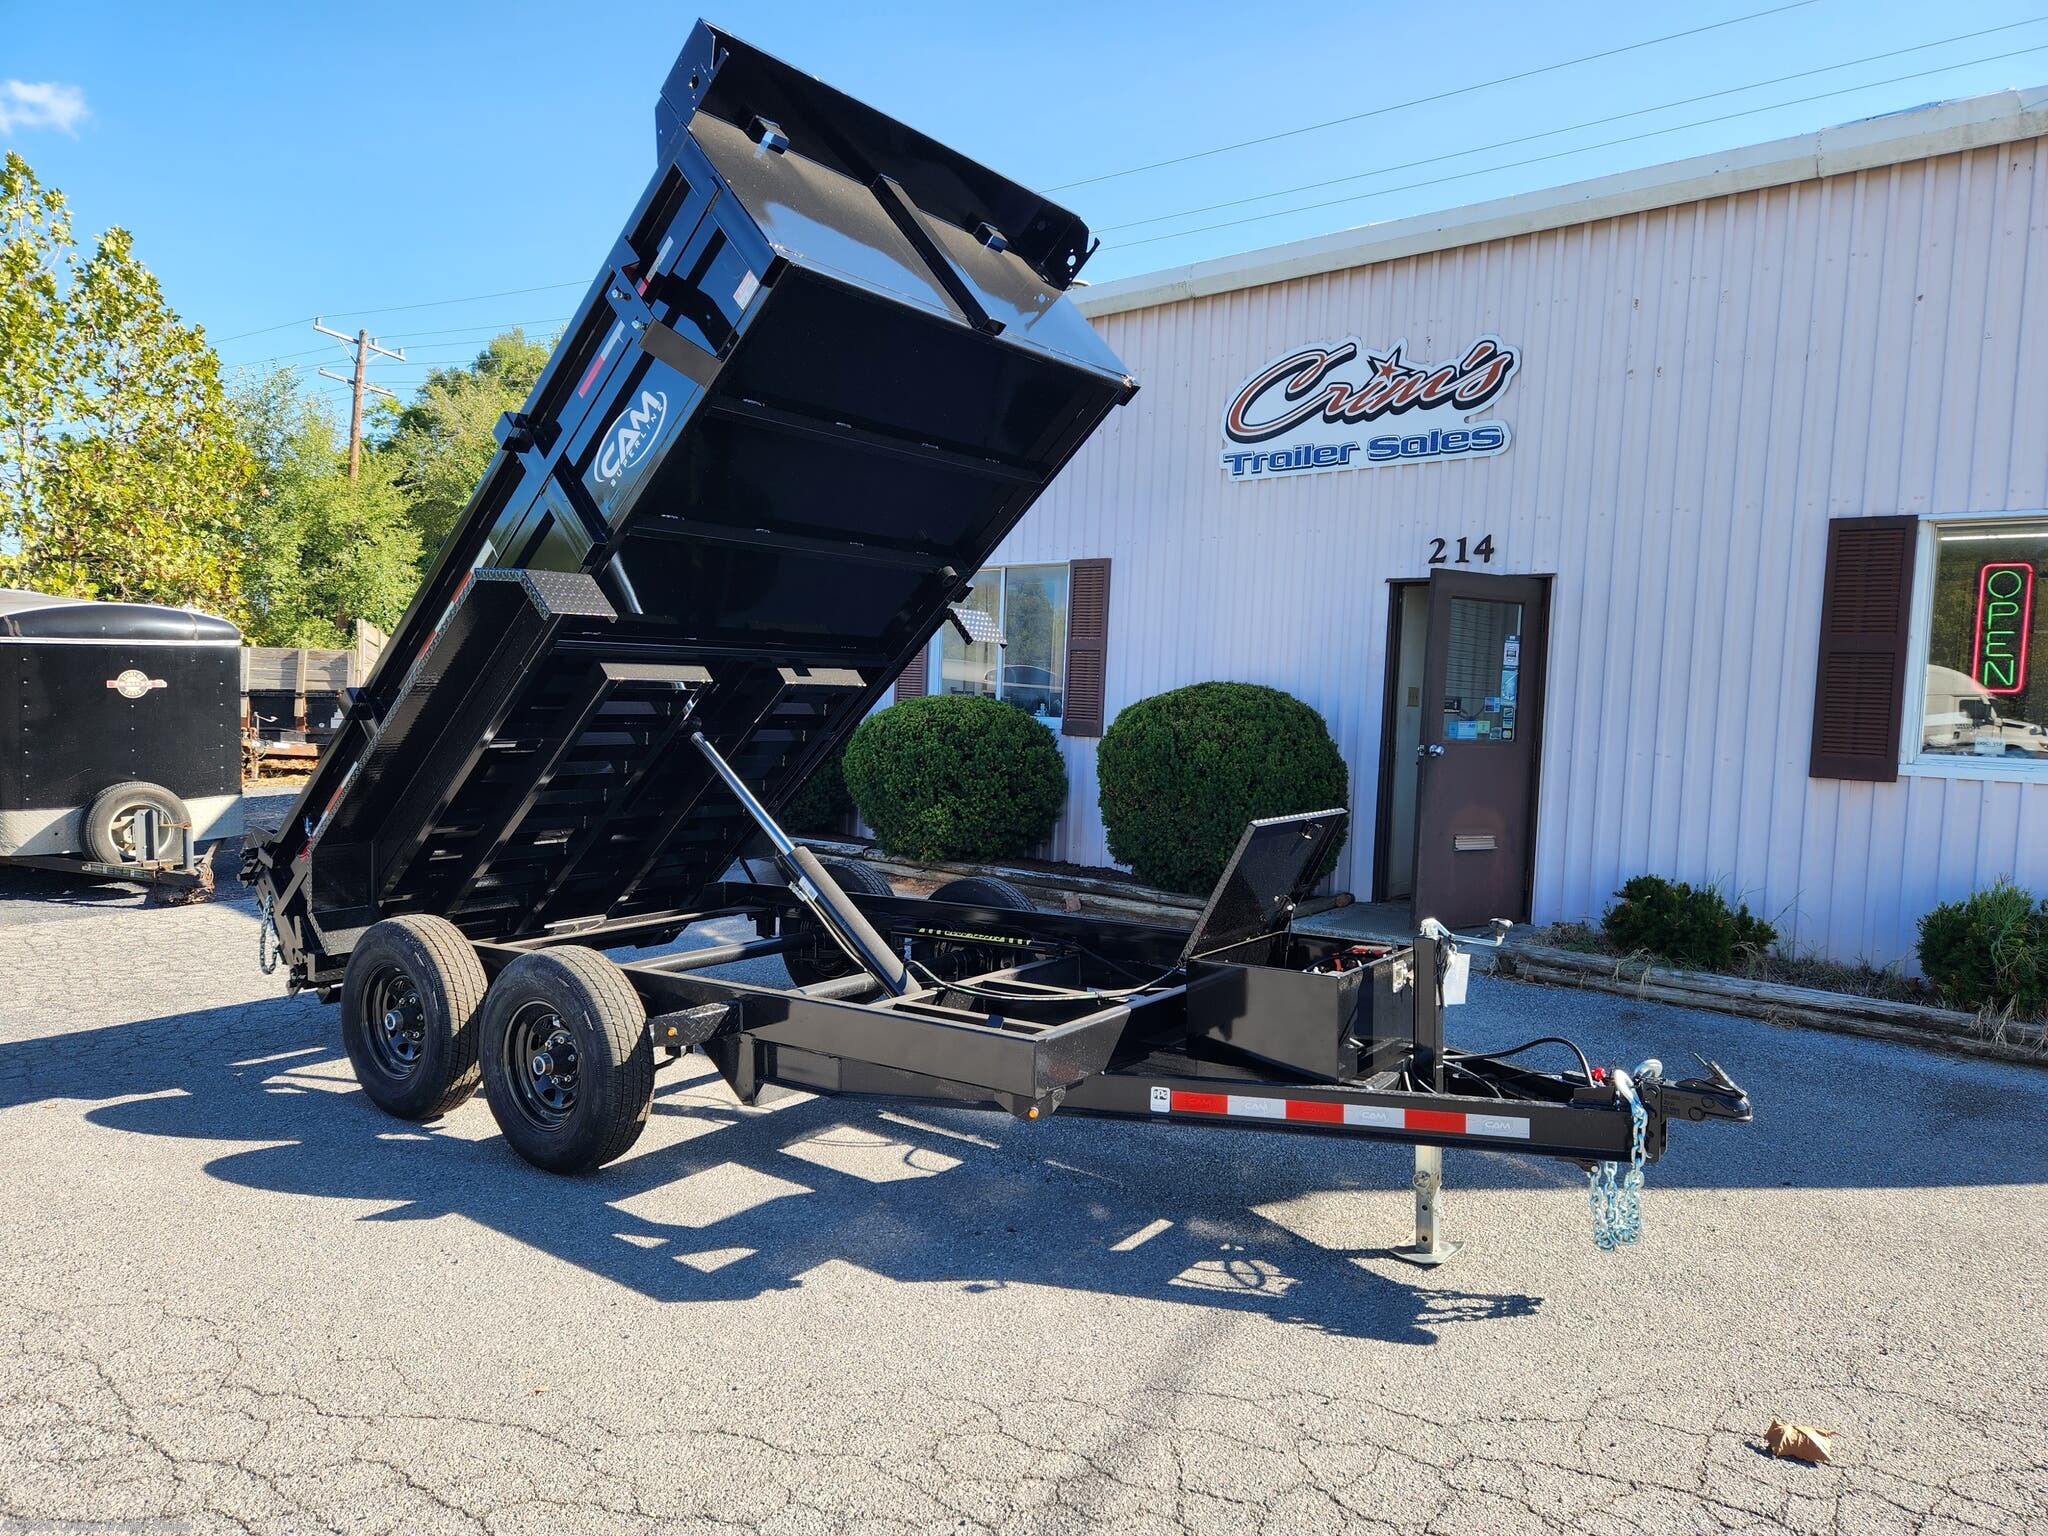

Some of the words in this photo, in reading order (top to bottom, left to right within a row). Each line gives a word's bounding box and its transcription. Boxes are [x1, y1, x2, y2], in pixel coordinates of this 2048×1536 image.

[1226, 340, 1514, 444] Crim's
[601, 391, 661, 477] CAM
[610, 403, 662, 487] SUPERLINE
[1223, 441, 1360, 475] Trailer
[1367, 425, 1505, 461] Sales
[1428, 534, 1494, 564] 214
[1984, 570, 2022, 686] OPEN
[1244, 1102, 1268, 1113] CAM
[1361, 1110, 1387, 1120] CAM
[1484, 1120, 1512, 1130] CAM
